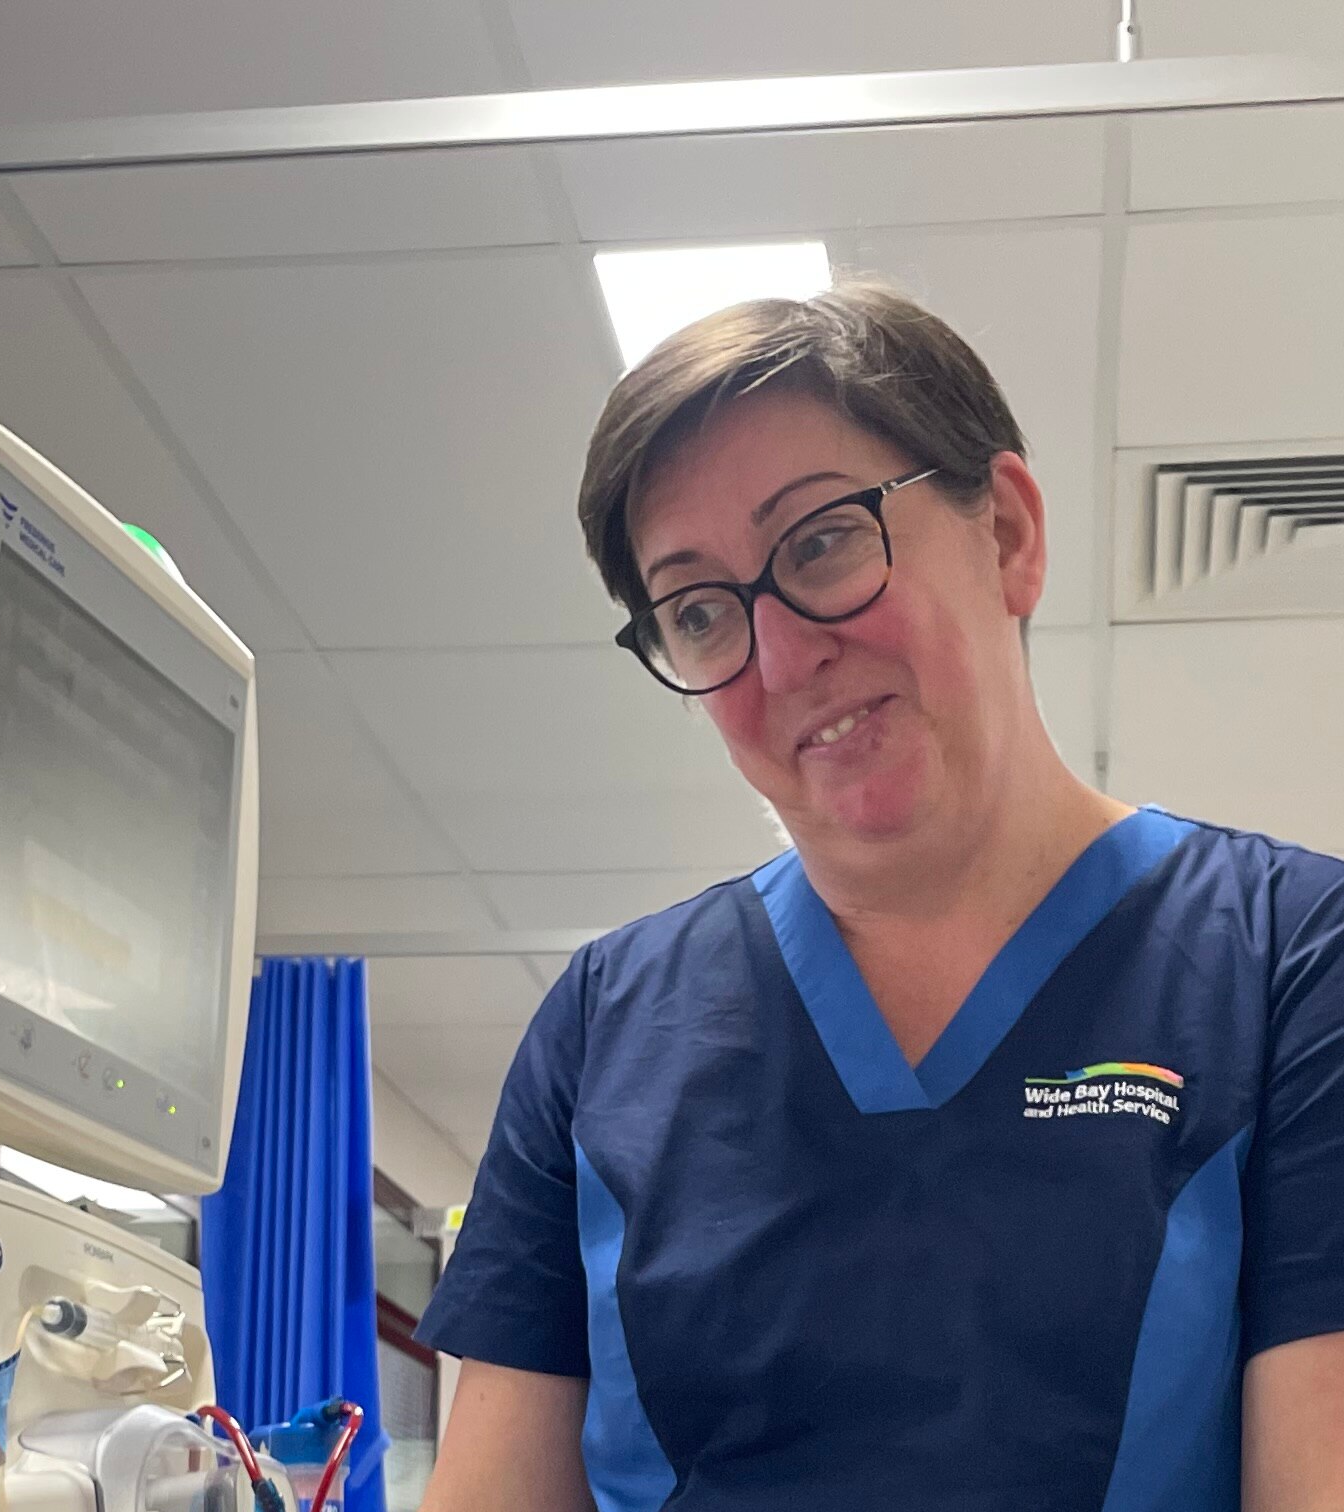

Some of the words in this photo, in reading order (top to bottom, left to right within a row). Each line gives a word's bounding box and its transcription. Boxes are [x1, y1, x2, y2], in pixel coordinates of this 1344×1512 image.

[1025, 1087, 1072, 1104] Wide
[1075, 1084, 1112, 1100] Bay
[1114, 1081, 1180, 1111] Hospital
[1023, 1106, 1054, 1119] and
[1057, 1100, 1109, 1118] Health
[1112, 1099, 1171, 1125] Service
